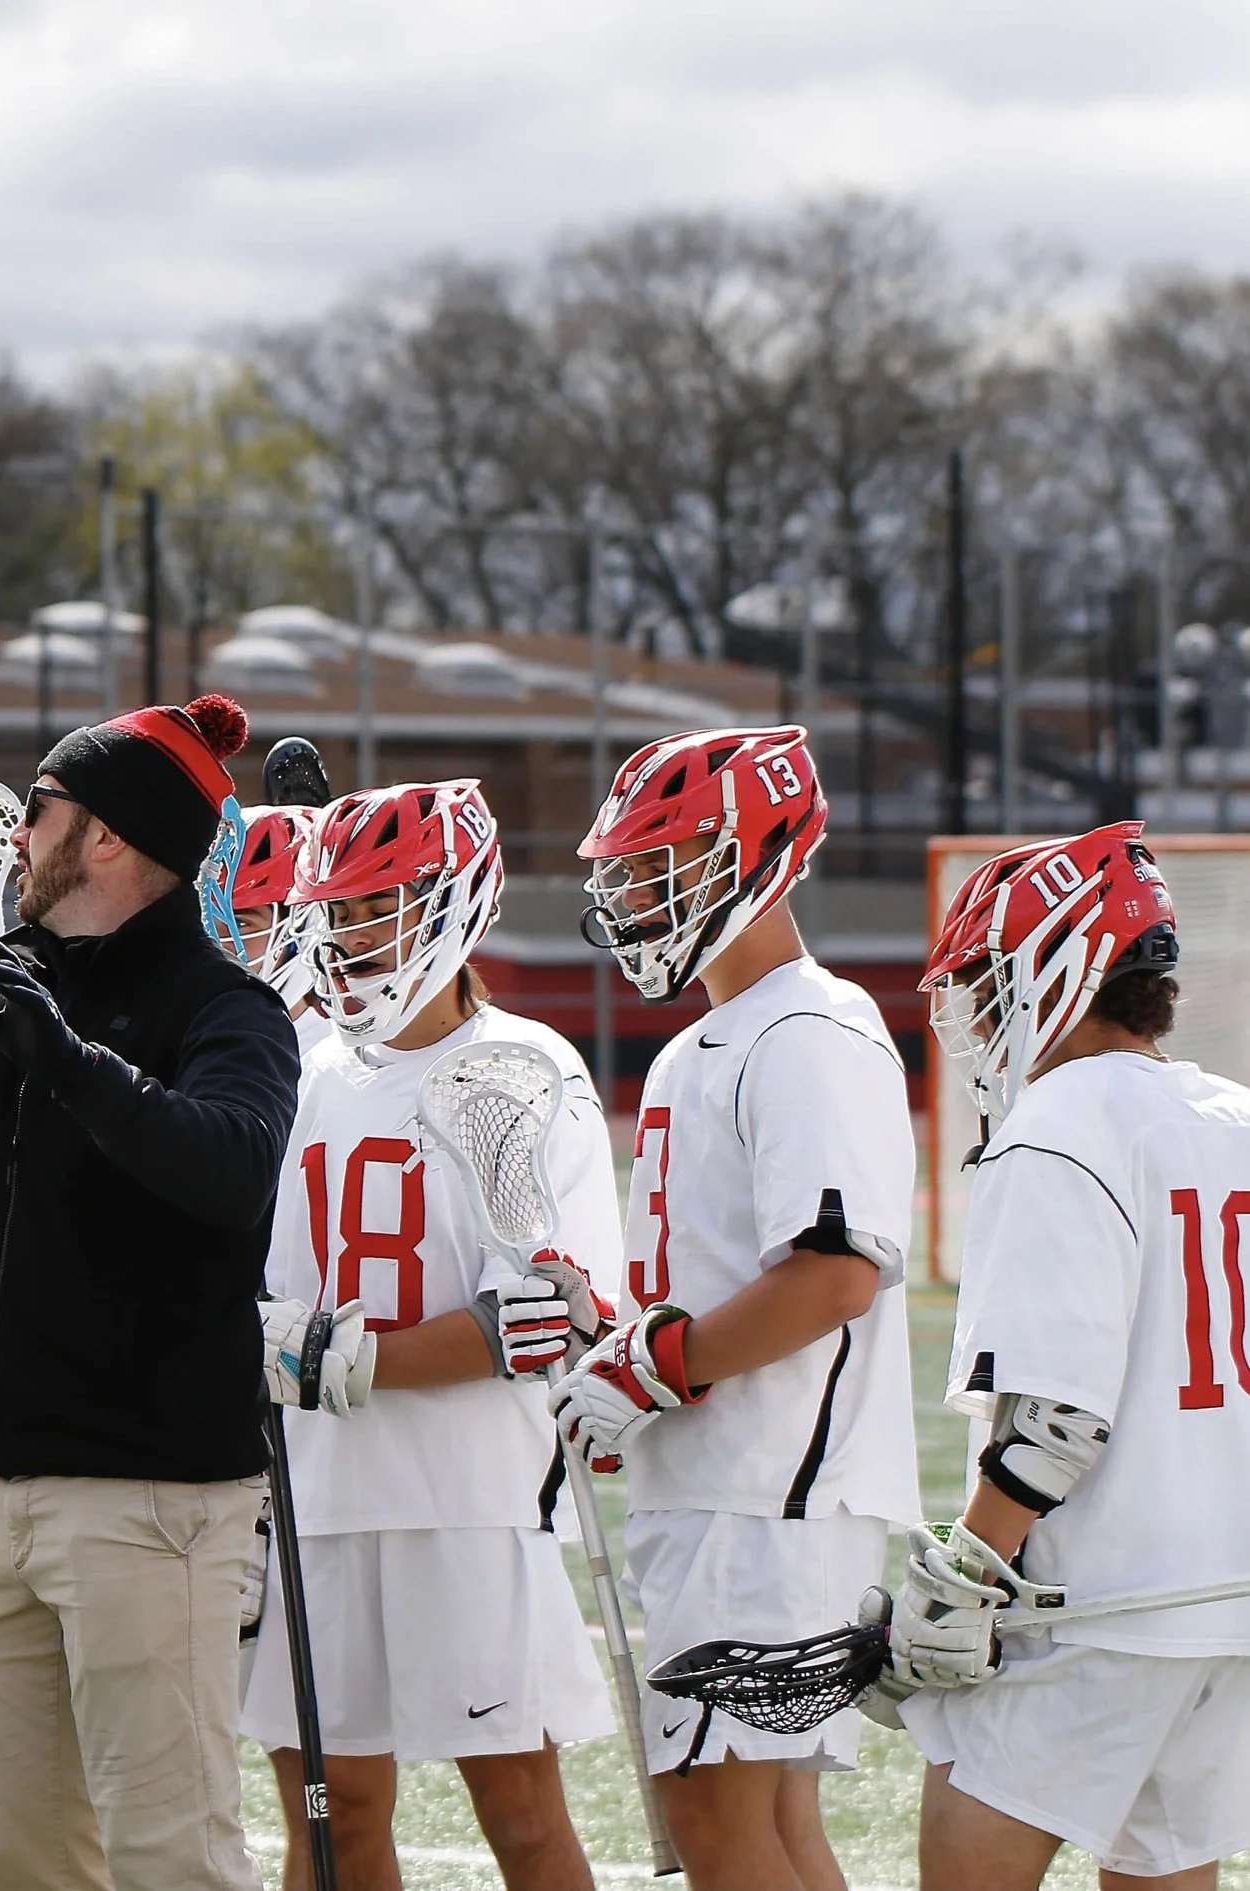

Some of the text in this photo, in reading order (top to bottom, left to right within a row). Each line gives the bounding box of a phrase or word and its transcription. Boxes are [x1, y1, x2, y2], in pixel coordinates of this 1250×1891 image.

[756, 756, 801, 805] 13
[455, 802, 488, 850] 18
[1029, 853, 1084, 909] 10
[299, 1136, 426, 1335] 18
